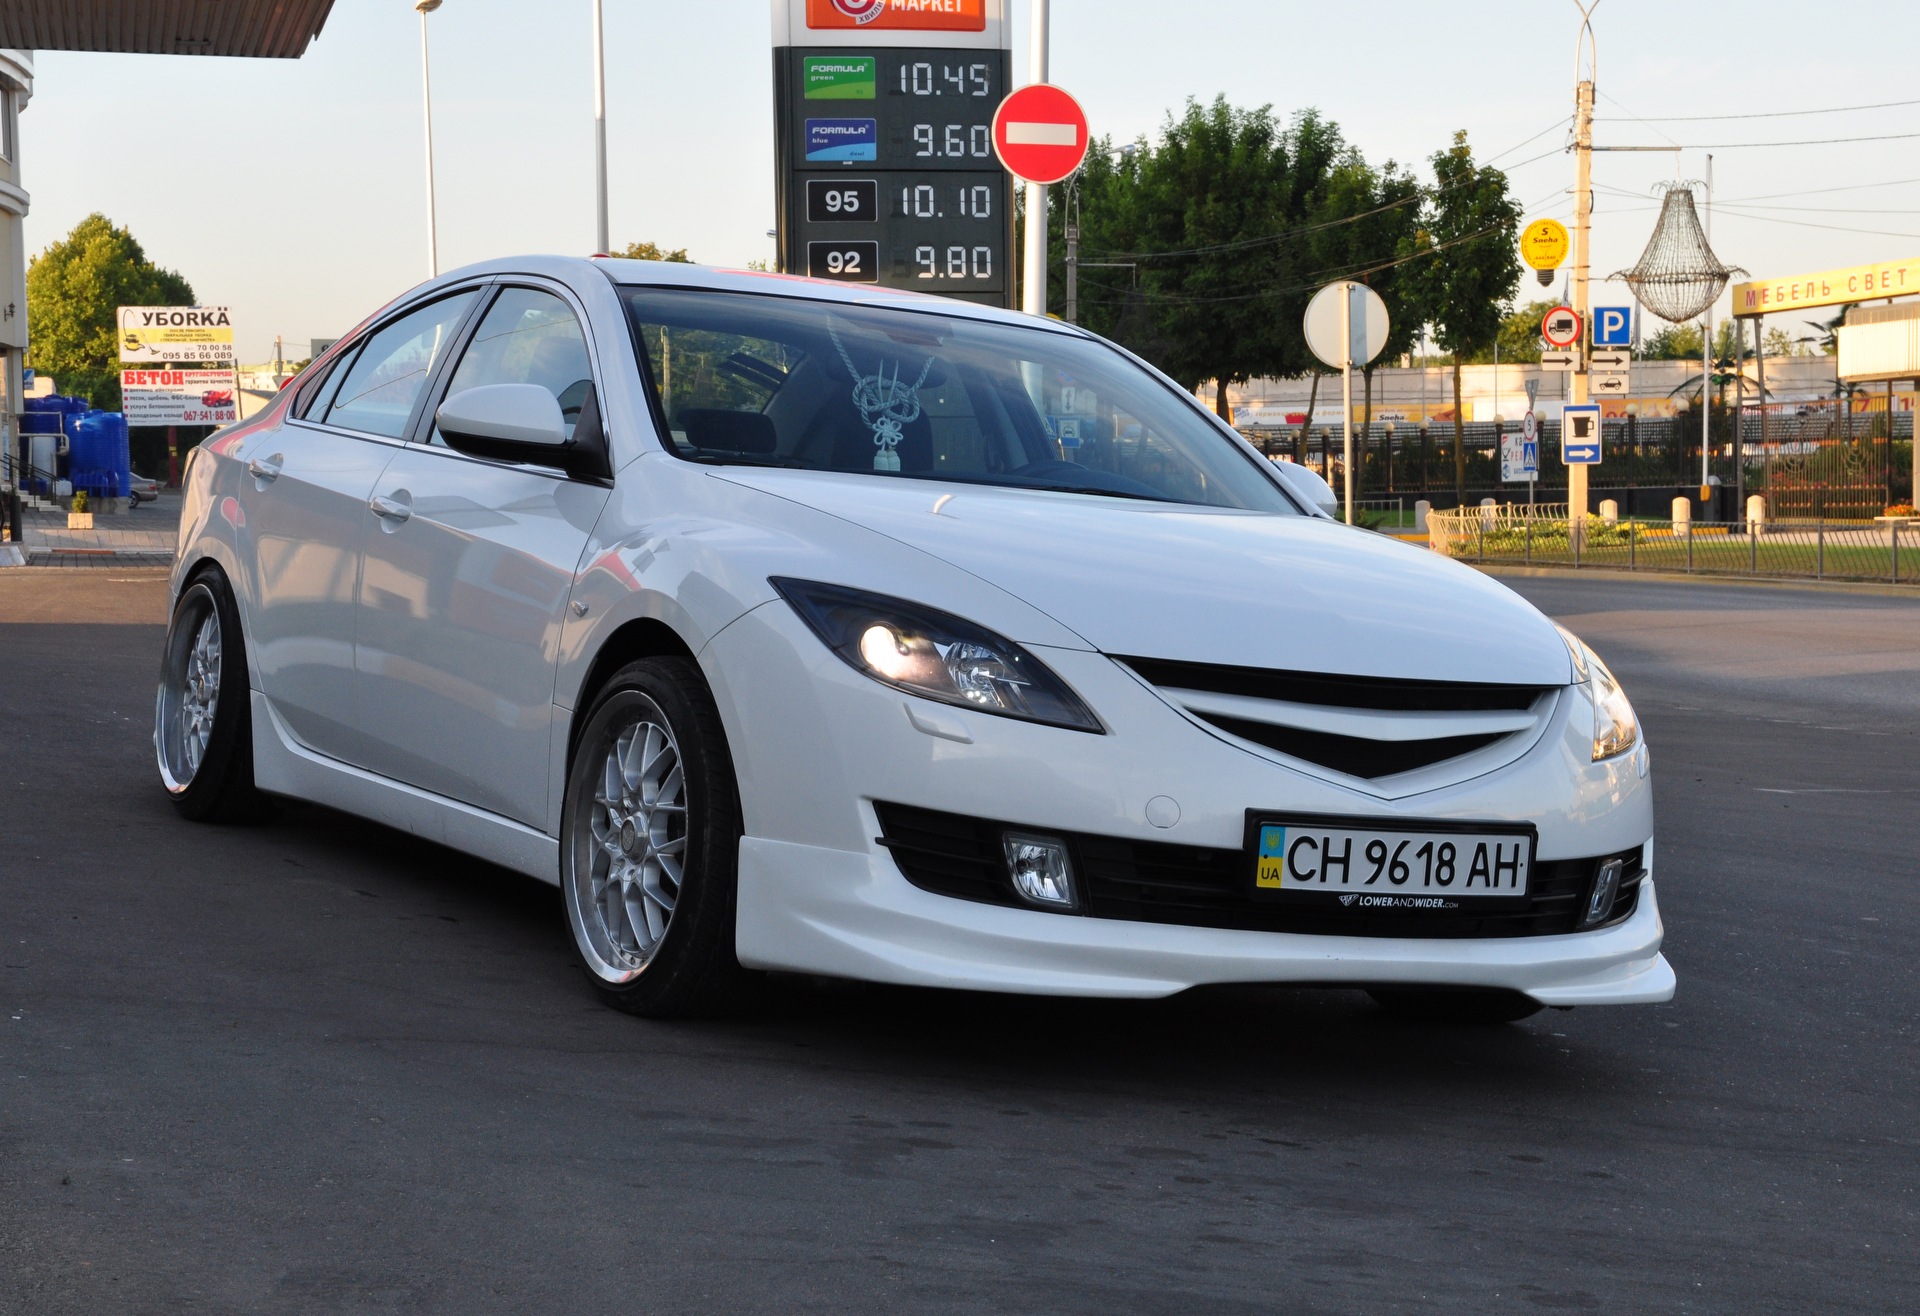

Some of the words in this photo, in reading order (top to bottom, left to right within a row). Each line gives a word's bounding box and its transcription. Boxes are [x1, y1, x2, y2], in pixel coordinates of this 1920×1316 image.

[859, 0, 884, 23] ХВИЛИ
[811, 65, 865, 73] FORMULA
[901, 63, 989, 96] 10.45
[812, 126, 866, 134] FORMULA
[914, 124, 990, 157] 9.60
[825, 190, 860, 212] 95
[827, 251, 861, 274] 92
[915, 246, 992, 278] 9.80
[1745, 280, 1831, 307] МЕБЕЛЬ
[1848, 268, 1907, 293] СВЕТ
[1603, 311, 1624, 342] P
[124, 371, 184, 385] БЕТОН
[1527, 420, 1532, 431] 5
[1261, 867, 1280, 880] UA
[1287, 836, 1352, 884] CH
[1364, 839, 1457, 887] 9618
[1466, 842, 1520, 888] AH
